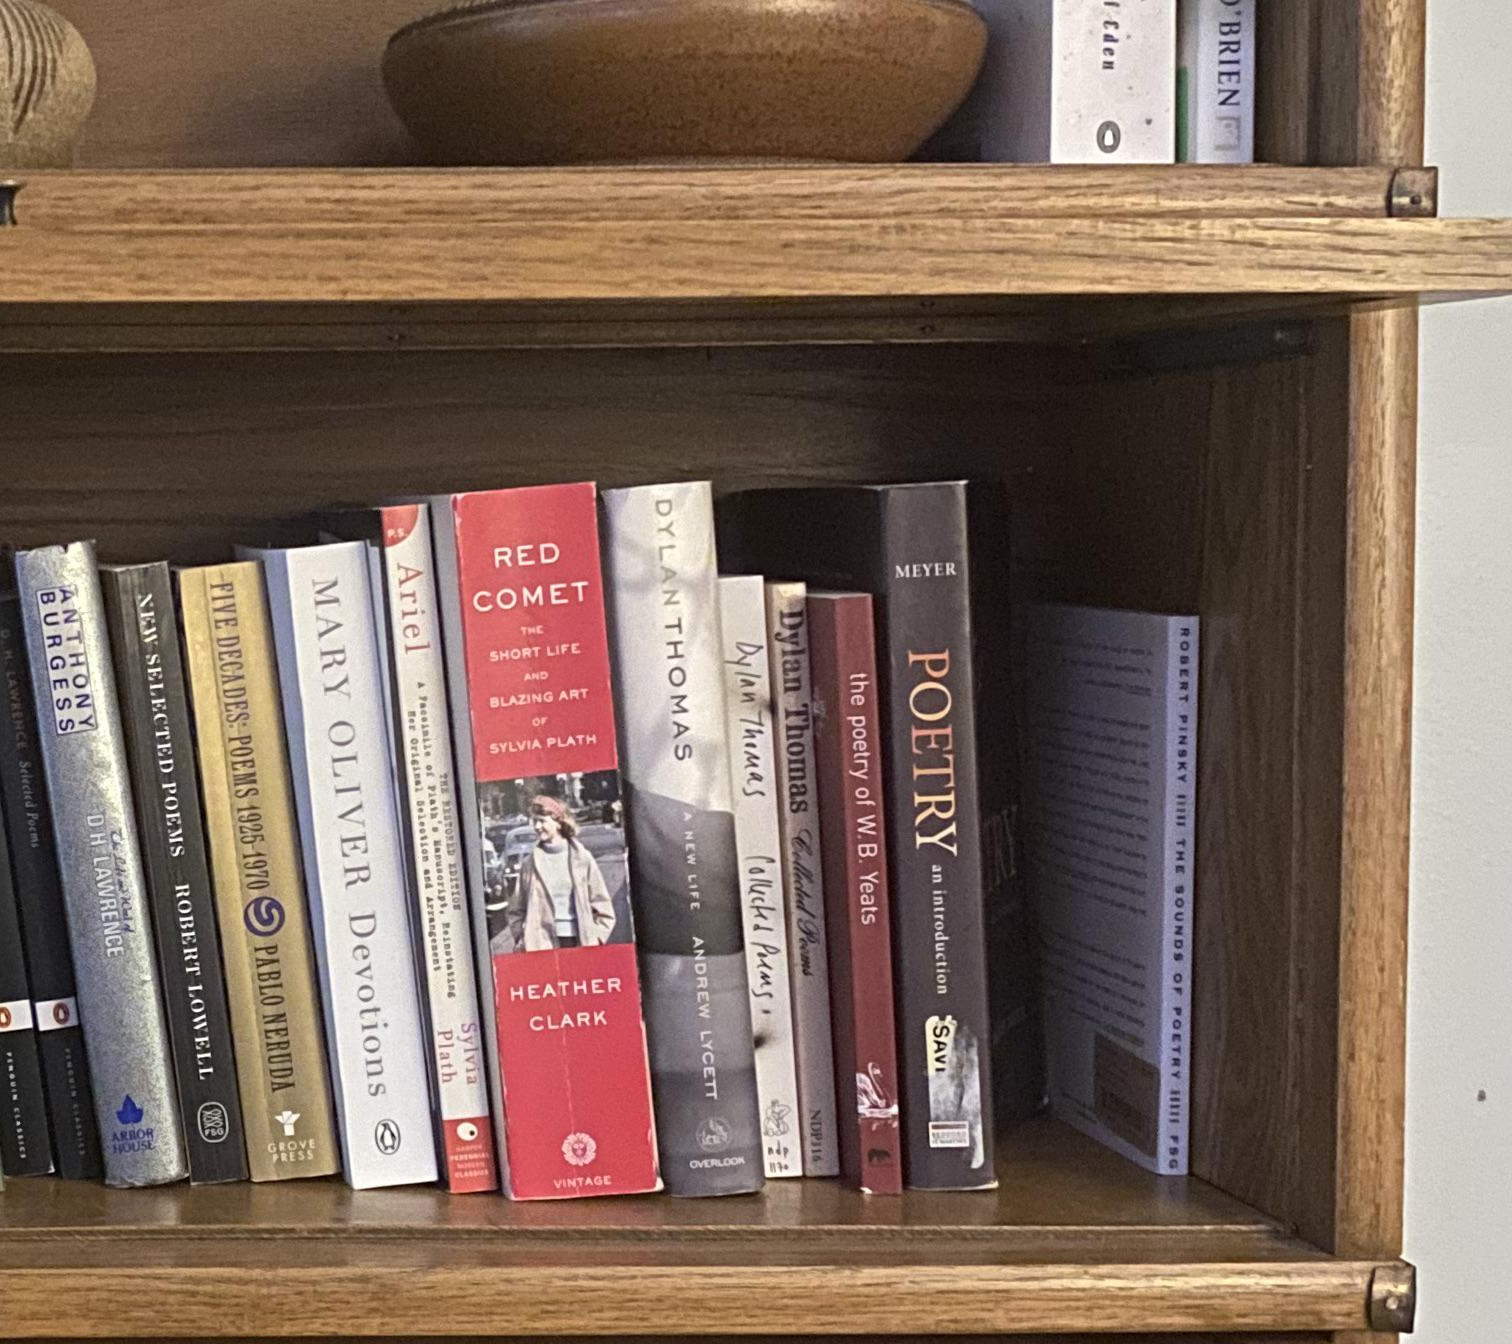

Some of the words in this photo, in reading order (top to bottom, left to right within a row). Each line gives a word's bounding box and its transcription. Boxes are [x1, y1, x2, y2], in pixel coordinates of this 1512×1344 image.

[1101, 19, 1119, 71] Eden
[494, 542, 560, 568] RED
[655, 498, 682, 606] DYLAN
[895, 561, 957, 579] MEYER
[138, 592, 159, 645] NEW
[210, 581, 237, 630] FIVE
[396, 562, 431, 655] Ariel
[472, 581, 589, 612] COMET
[39, 591, 76, 733] BURGESS
[59, 588, 96, 729] ANTHONY
[311, 576, 352, 699] MARY
[489, 646, 541, 662] SHORT
[546, 642, 582, 656] LIFE
[774, 608, 806, 693] Dylan
[144, 652, 174, 776] SELECTED
[489, 690, 554, 709] BLAZING
[558, 688, 589, 701] ART
[663, 616, 693, 763] THOMAS
[848, 671, 870, 706] the
[228, 735, 259, 799] POEMS
[489, 739, 542, 755] SYLVIA
[546, 734, 597, 748] PLATH
[785, 697, 809, 814] Thomas
[845, 713, 871, 779] poetry
[907, 648, 959, 858] POETRY
[161, 781, 185, 858] POEMS
[328, 720, 372, 889] OLIVER
[854, 783, 872, 807] of
[237, 798, 269, 891] 1925-1970
[855, 812, 879, 866] W.B.
[859, 870, 880, 926] Yeats
[931, 864, 942, 884] an
[175, 883, 202, 977] ROBERT
[932, 889, 948, 995] introduction
[254, 943, 285, 1008] PABLO
[348, 912, 388, 1098] Devotions
[510, 977, 623, 1002] HEATHER
[691, 935, 711, 1019] ANDREW
[188, 983, 214, 1082] LOWELL
[263, 1012, 296, 1094] NERUDA
[529, 1010, 609, 1032] CLARK
[699, 1030, 719, 1101] LYCETT
[267, 1138, 317, 1154] GROVE
[272, 1148, 314, 1163] PRESS
[689, 1155, 746, 1170] OVERLOOK
[553, 1174, 613, 1190] VINTAGE
